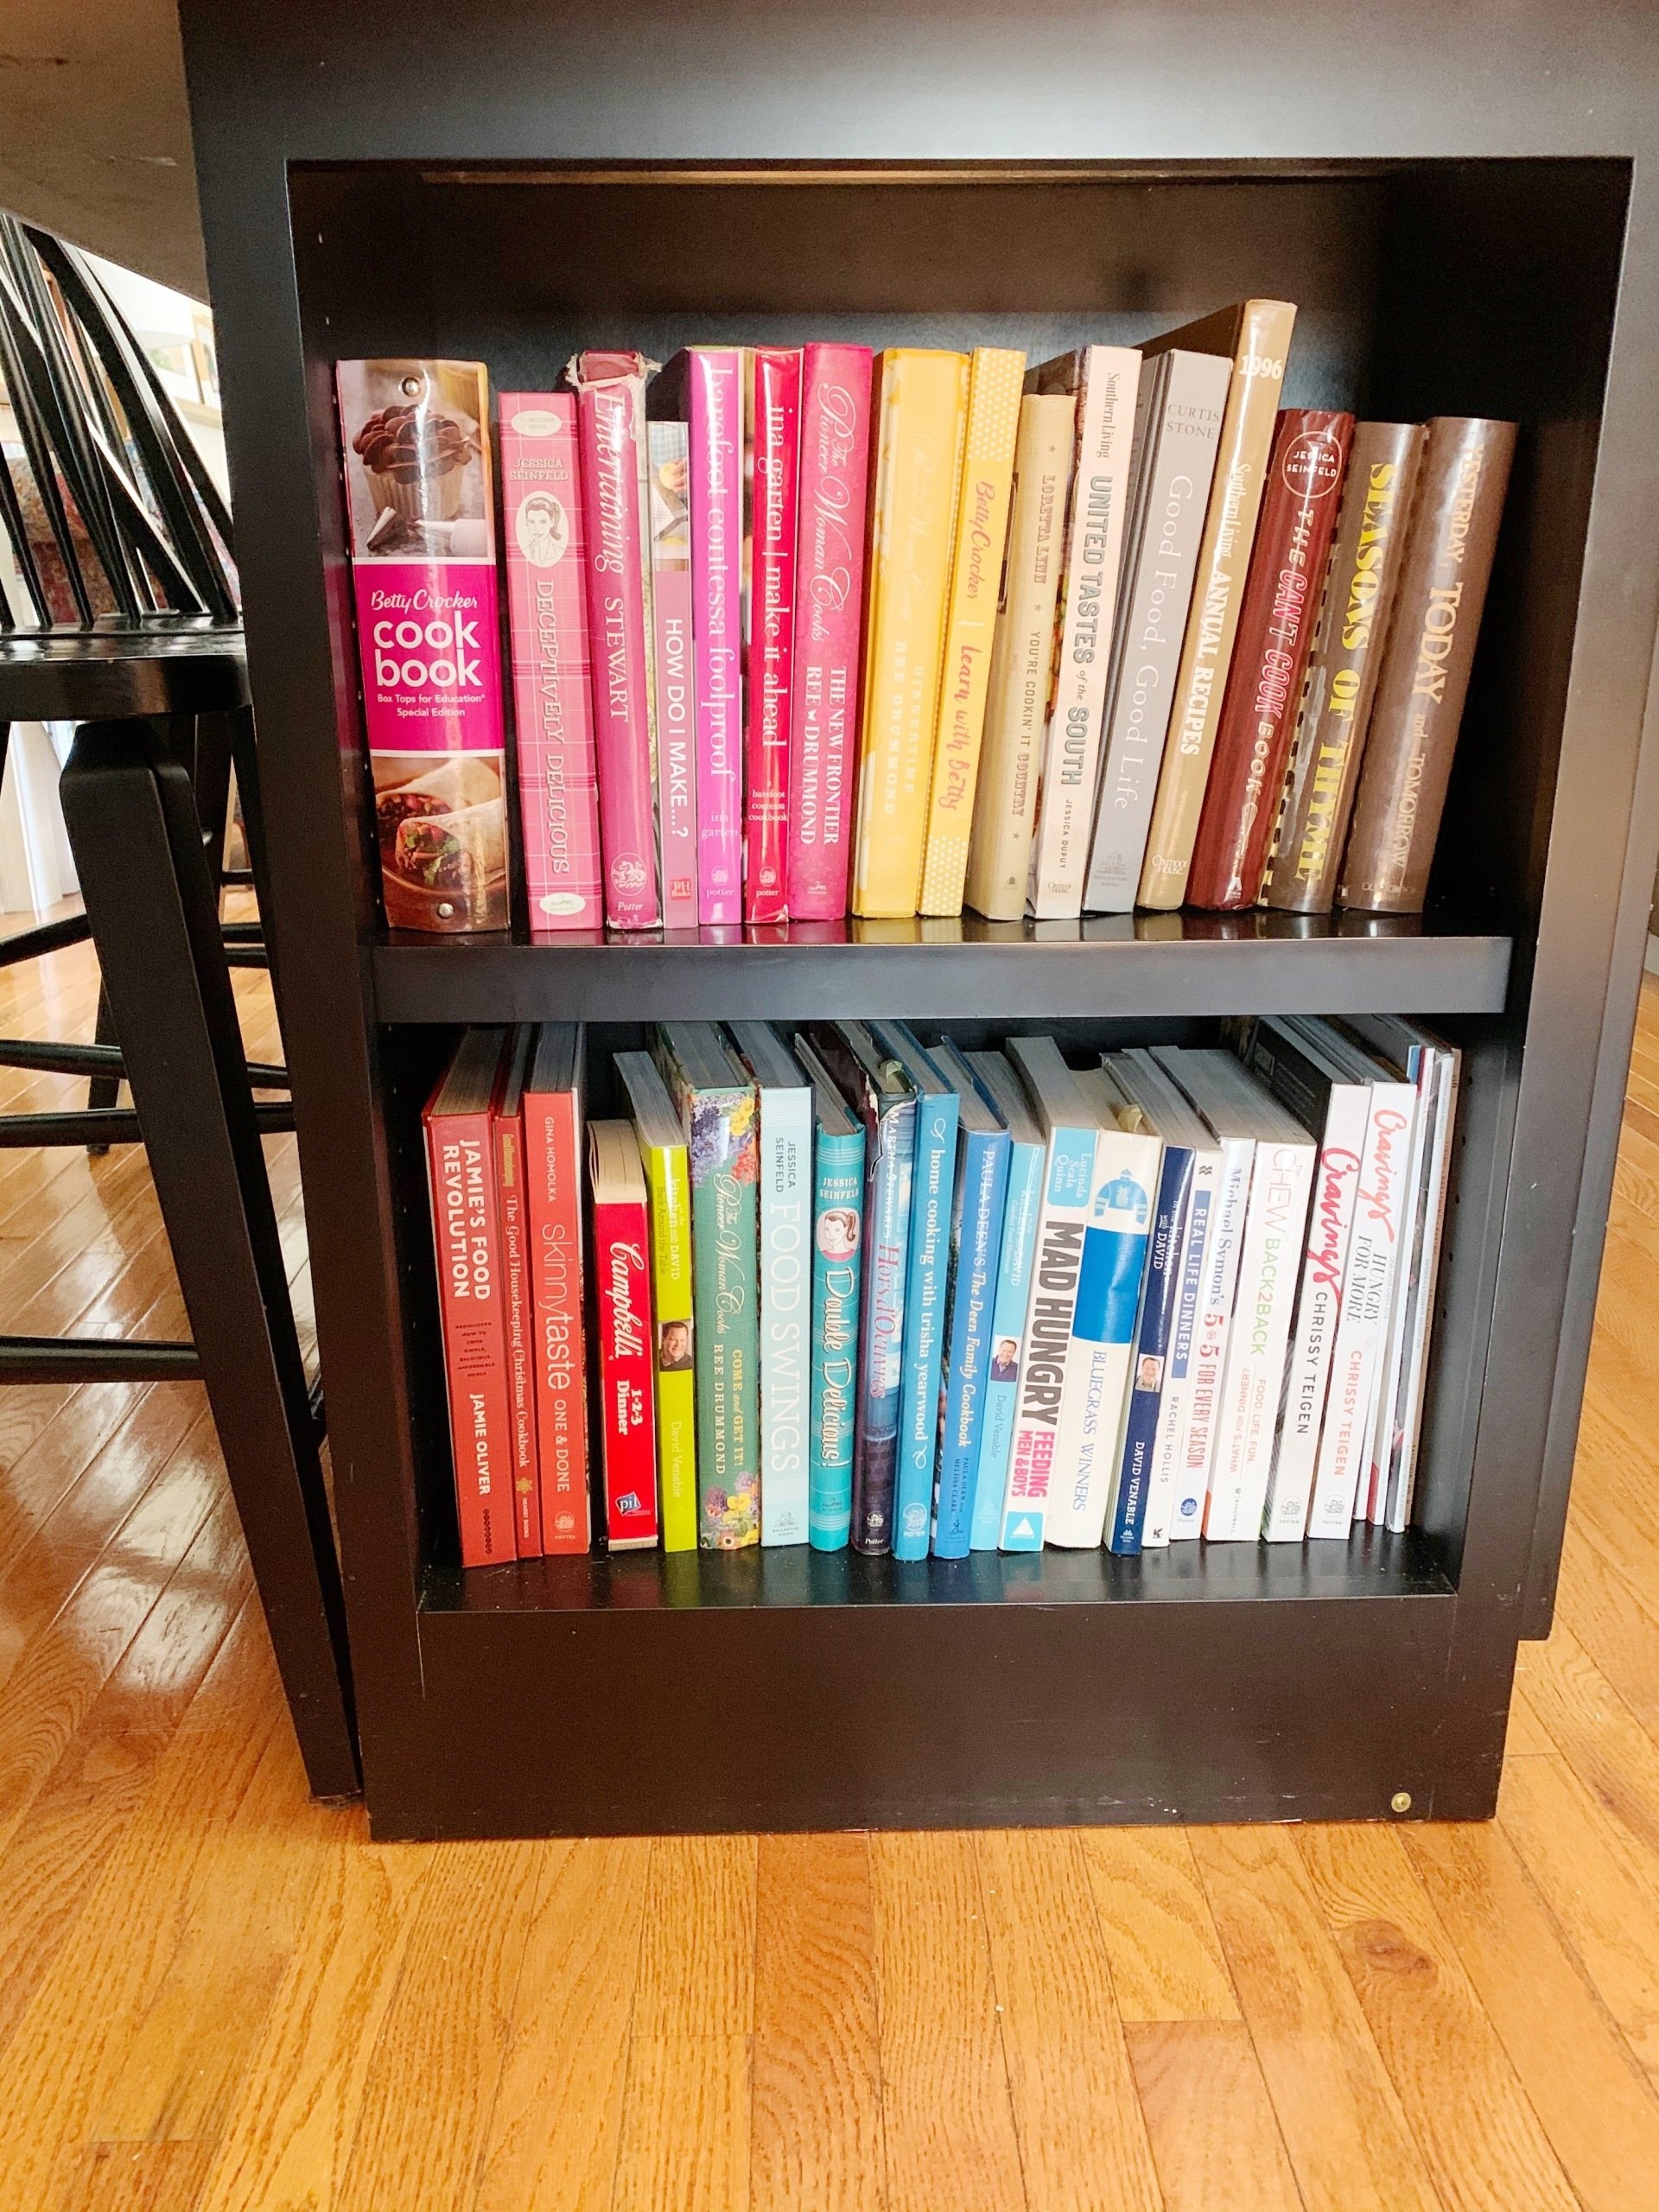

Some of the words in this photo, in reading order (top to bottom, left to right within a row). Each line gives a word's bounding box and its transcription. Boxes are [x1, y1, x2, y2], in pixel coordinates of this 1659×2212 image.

[1239, 355, 1283, 380] 1996
[1101, 372, 1121, 425] Southern
[1167, 404, 1221, 421] CURTIS
[707, 367, 733, 496] barefoot
[771, 407, 794, 445] ina
[817, 382, 856, 477] Pioneer
[830, 436, 848, 467] The
[1096, 425, 1116, 460] Living
[1166, 422, 1216, 439] STONE
[510, 470, 569, 482] SEINFELD
[513, 458, 563, 469] JESSICA
[594, 388, 630, 574] Entertaining
[757, 456, 785, 541] garten
[813, 476, 853, 573] Woman
[969, 480, 995, 524] Betty
[1038, 476, 1056, 542] LORETTA
[1084, 476, 1114, 564] UNITED
[1158, 475, 1193, 558] Good
[965, 524, 991, 601] Crocker
[1033, 543, 1052, 585] LYNN
[1288, 509, 1314, 568] THE
[1342, 463, 1398, 650] SEASONS
[708, 508, 729, 637] contessa
[371, 590, 411, 614] Betty
[412, 589, 478, 610] Crocker
[765, 567, 790, 637] make
[808, 566, 851, 643] Cooks
[1073, 572, 1103, 664] TASTES
[1141, 569, 1177, 652] Food,
[1268, 569, 1308, 646] CAN'T
[373, 610, 481, 649] cook
[665, 619, 685, 678] HOW
[763, 647, 788, 662] it
[375, 649, 483, 687] book
[537, 579, 564, 745] DECEPTIVELY
[605, 597, 629, 722] STEWART
[805, 665, 823, 706] REE
[830, 665, 847, 704] THE
[893, 640, 906, 683] REE
[1079, 670, 1088, 682] of
[1255, 649, 1293, 719] COOK
[378, 694, 393, 703] Box
[395, 694, 416, 704] Tops
[418, 693, 432, 703] for
[397, 707, 429, 717] Special
[431, 707, 466, 716] Edition
[667, 686, 685, 722] DO
[701, 649, 736, 782] foolproof
[762, 672, 788, 747] ahead
[1077, 683, 1087, 701] the
[1125, 664, 1159, 744] Good
[1329, 669, 1361, 721] OF
[829, 710, 845, 753] NEW
[885, 694, 903, 816] DRUMMOND
[906, 665, 924, 795] DINNERTIME
[1061, 707, 1090, 785] SOUTH
[1114, 753, 1145, 810] Life
[1245, 721, 1275, 796] BOOK
[669, 742, 689, 837] MAKE...?
[751, 802, 785, 810] contessa
[752, 790, 785, 799] barefoot
[800, 726, 819, 845] DRUMMOND
[823, 754, 844, 845] FRONTIER
[1294, 741, 1349, 881] THYME
[546, 754, 569, 874] DELICIOUS
[748, 814, 788, 823] cookbook
[1063, 799, 1072, 836] JESSICA
[1058, 840, 1070, 869] DUPUY
[706, 888, 734, 899] potter
[756, 888, 779, 899] potter
[544, 1116, 554, 1144] GINA
[459, 1140, 486, 1229] JAMIE'S
[546, 1147, 558, 1203] HOMOLKA
[775, 1137, 784, 1193] SEINFELD
[787, 1141, 797, 1188] JESSICA
[823, 1177, 858, 1188] JESSICA
[929, 1148, 946, 1195] home
[979, 1150, 995, 1204] PAULA
[1053, 1154, 1070, 1192] Quinn
[1066, 1160, 1079, 1189] Scala
[1076, 1153, 1092, 1198] Lucinda
[1357, 1109, 1408, 1243] Cravings
[442, 1145, 471, 1298] REVOLUTION
[505, 1194, 519, 1222] The
[919, 1201, 942, 1267] cooking
[1191, 1208, 1206, 1247] REAL
[1306, 1147, 1362, 1311] Cravings
[506, 1226, 520, 1261] Good
[770, 1201, 801, 1313] FOOD
[974, 1208, 990, 1267] DEEN'S
[1039, 1220, 1084, 1292] MAD
[1154, 1231, 1167, 1269] DAVID
[1355, 1235, 1372, 1270] FOR
[471, 1236, 491, 1300] FOOD
[876, 1243, 899, 1296] Hors
[921, 1271, 938, 1307] with
[971, 1271, 987, 1296] The
[1185, 1255, 1202, 1287] LIFE
[1363, 1252, 1388, 1325] HUNGRY
[509, 1262, 523, 1347] Housekeeping
[823, 1267, 855, 1355] Double
[968, 1299, 984, 1332] Deen
[1346, 1270, 1368, 1323] MORE
[870, 1299, 897, 1399] d'Oeuvres
[918, 1310, 934, 1359] trisha
[1176, 1293, 1195, 1361] DINNERS
[1306, 1292, 1328, 1366] CHRISSY
[511, 1350, 526, 1408] Christmas
[714, 1344, 724, 1376] REE
[732, 1350, 743, 1391] COME
[960, 1334, 980, 1380] Family
[1021, 1298, 1074, 1426] HUNGRY
[1344, 1351, 1363, 1416] CHRISSY
[469, 1394, 487, 1438] JAMIE
[554, 1399, 568, 1432] ONE
[616, 1380, 629, 1436] Dinner
[631, 1389, 644, 1426] 1-2-3
[733, 1394, 743, 1414] and
[770, 1322, 801, 1472] SWINGS
[822, 1357, 854, 1468] Delicious!
[913, 1362, 931, 1441] yearwood
[957, 1384, 977, 1447] Cookbook
[1083, 1351, 1107, 1435] BLUEGRASS
[1237, 1368, 1251, 1412] DINNER?
[1296, 1374, 1316, 1434] TEIGEN
[516, 1411, 531, 1467] Cookbook
[555, 1435, 569, 1446] &
[714, 1382, 726, 1474] DRUMMOND
[733, 1414, 744, 1442] GET
[1018, 1430, 1033, 1456] MEN
[1168, 1396, 1179, 1439] RACHEL
[1236, 1415, 1244, 1432] FOR
[475, 1440, 491, 1496] OLIVER
[556, 1449, 570, 1492] DONE
[734, 1445, 745, 1467] IT!
[1014, 1458, 1026, 1467] &
[1027, 1431, 1055, 1497] FEEDING
[1131, 1440, 1145, 1476] DAVID
[1160, 1444, 1173, 1484] HOLLIS
[1229, 1434, 1243, 1474] WHAT'S
[1334, 1420, 1352, 1476] TEIGEN
[619, 1496, 638, 1510] pil
[1012, 1468, 1029, 1497] BOYS
[1072, 1442, 1095, 1511] WINNERS
[1125, 1477, 1141, 1525] VENABLE
